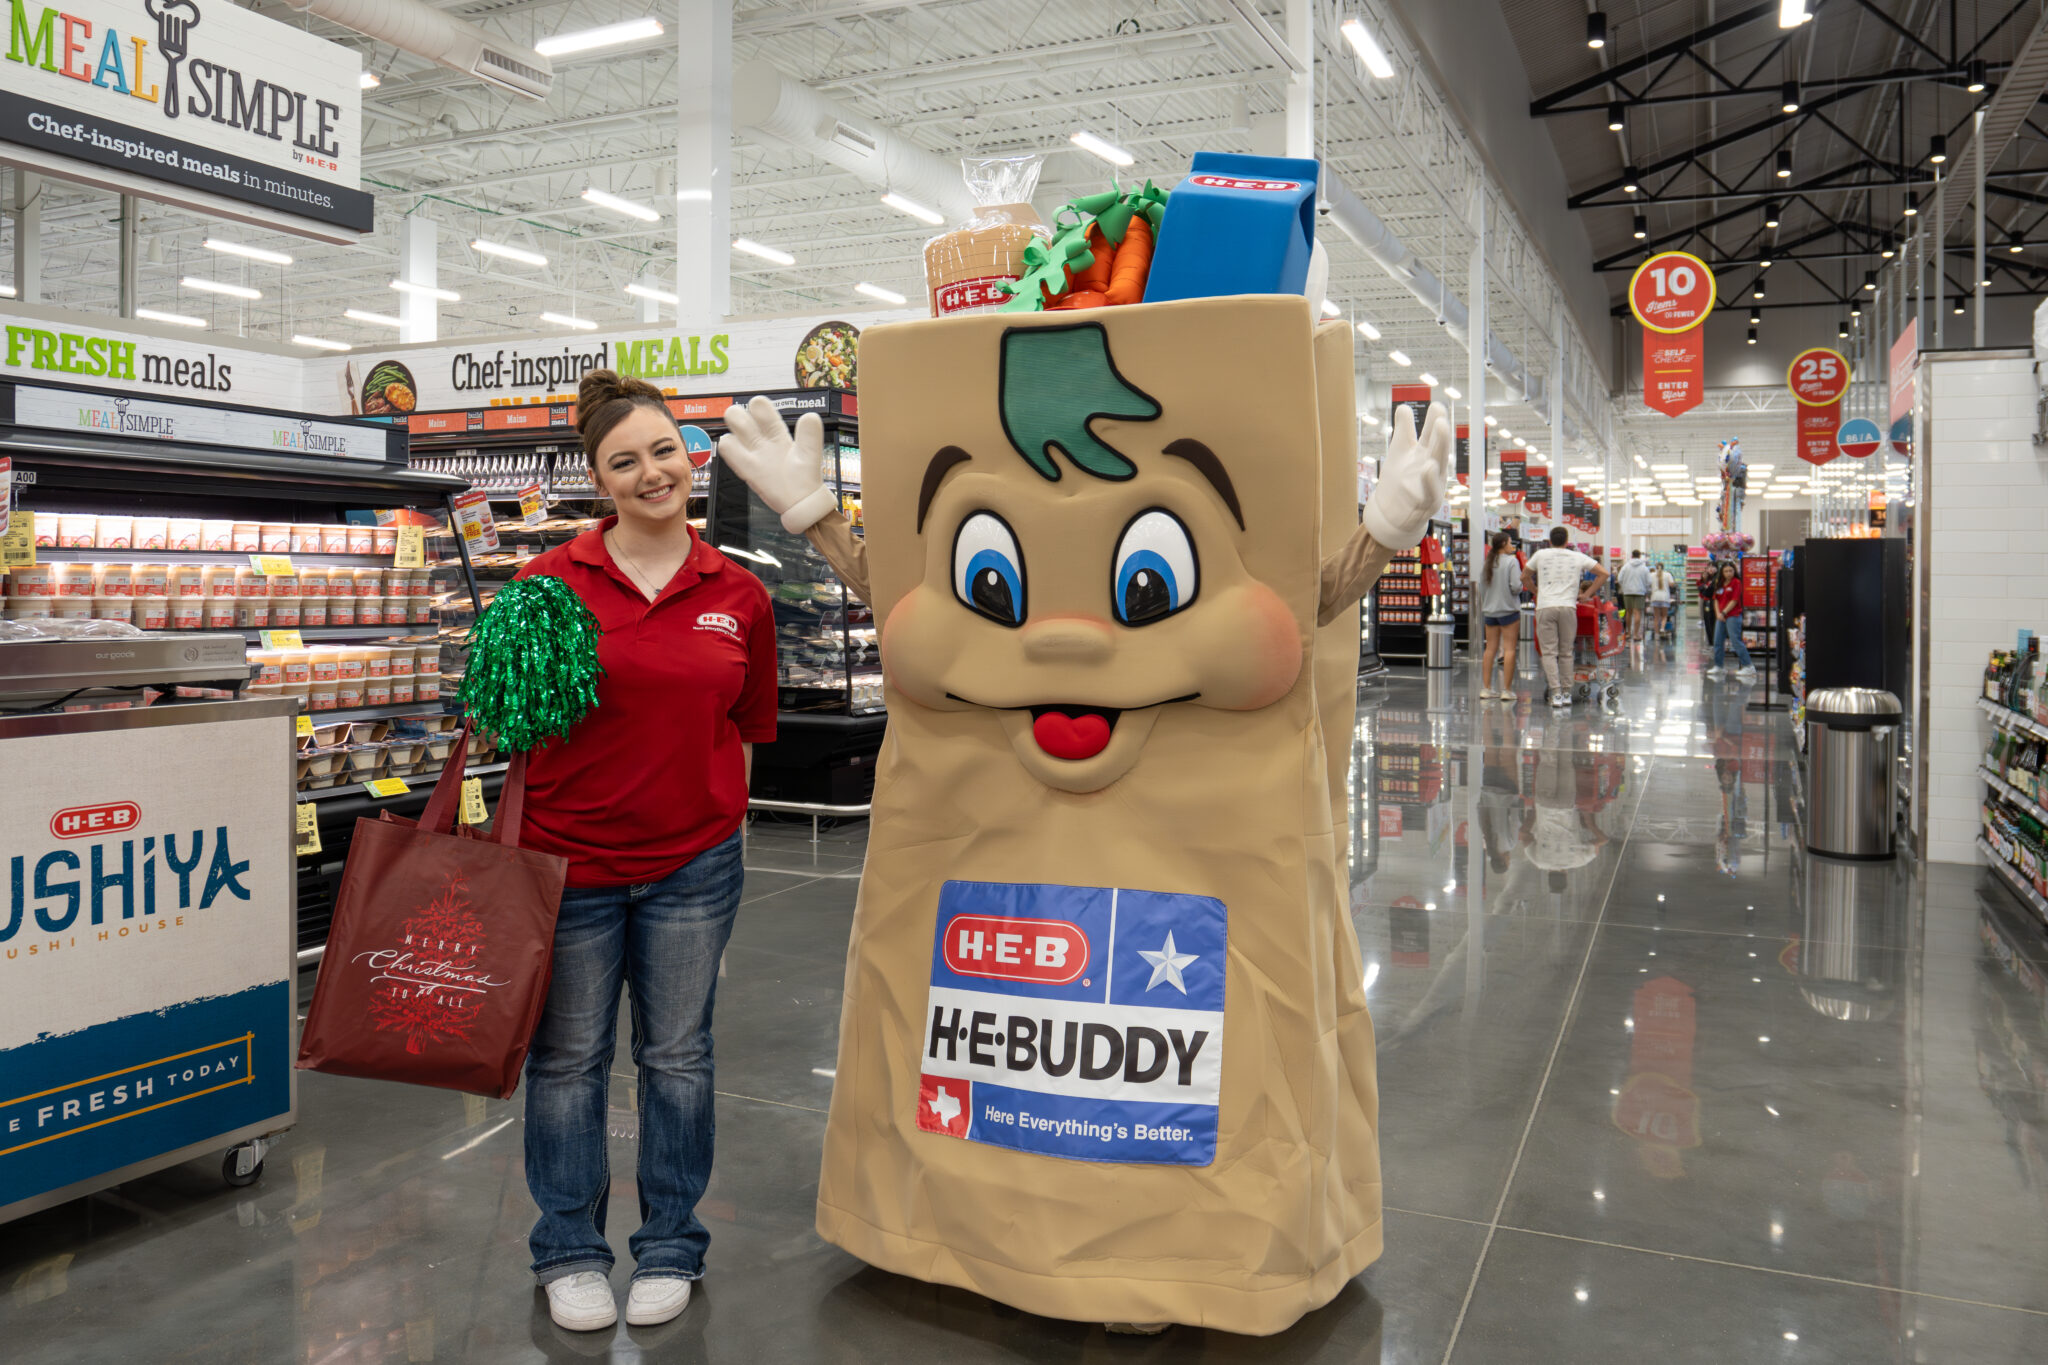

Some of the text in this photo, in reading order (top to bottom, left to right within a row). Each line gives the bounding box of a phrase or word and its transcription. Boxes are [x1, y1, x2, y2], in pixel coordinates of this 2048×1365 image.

[6, 0, 340, 158] MEAL SIMPLE
[28, 112, 335, 210] Chef-inspired meals in minutes.
[292, 149, 304, 163] by
[1650, 266, 1697, 297] 10
[1645, 299, 1678, 313] Items
[1673, 310, 1696, 318] FEWER
[6, 325, 232, 391] FRESH meals
[1664, 349, 1686, 357] SELF
[452, 334, 730, 392] Chef-inspired MEALS
[1800, 358, 1837, 381] 25
[1658, 381, 1689, 390] ENTER
[797, 396, 826, 409] meal
[1662, 390, 1687, 401] Here
[551, 406, 567, 414] build
[684, 404, 707, 415] Mains
[78, 408, 174, 435] MEAL SIMPLE
[393, 415, 408, 423] build
[428, 418, 447, 428] Mains
[506, 414, 527, 424] Mains
[272, 429, 346, 453] MEAL SIMPLE
[15, 472, 35, 483] A00
[1508, 492, 1519, 501] 17
[1531, 503, 1542, 512] 18
[7, 915, 185, 960] USHI HOUSE
[405, 934, 477, 956] MERRY
[351, 949, 512, 987] Christmas
[392, 987, 463, 1008] TO ALL
[37, 1077, 155, 1128] FRESH
[167, 1055, 240, 1087] TODAY
[984, 1104, 1194, 1142] Here Everything's Better.
